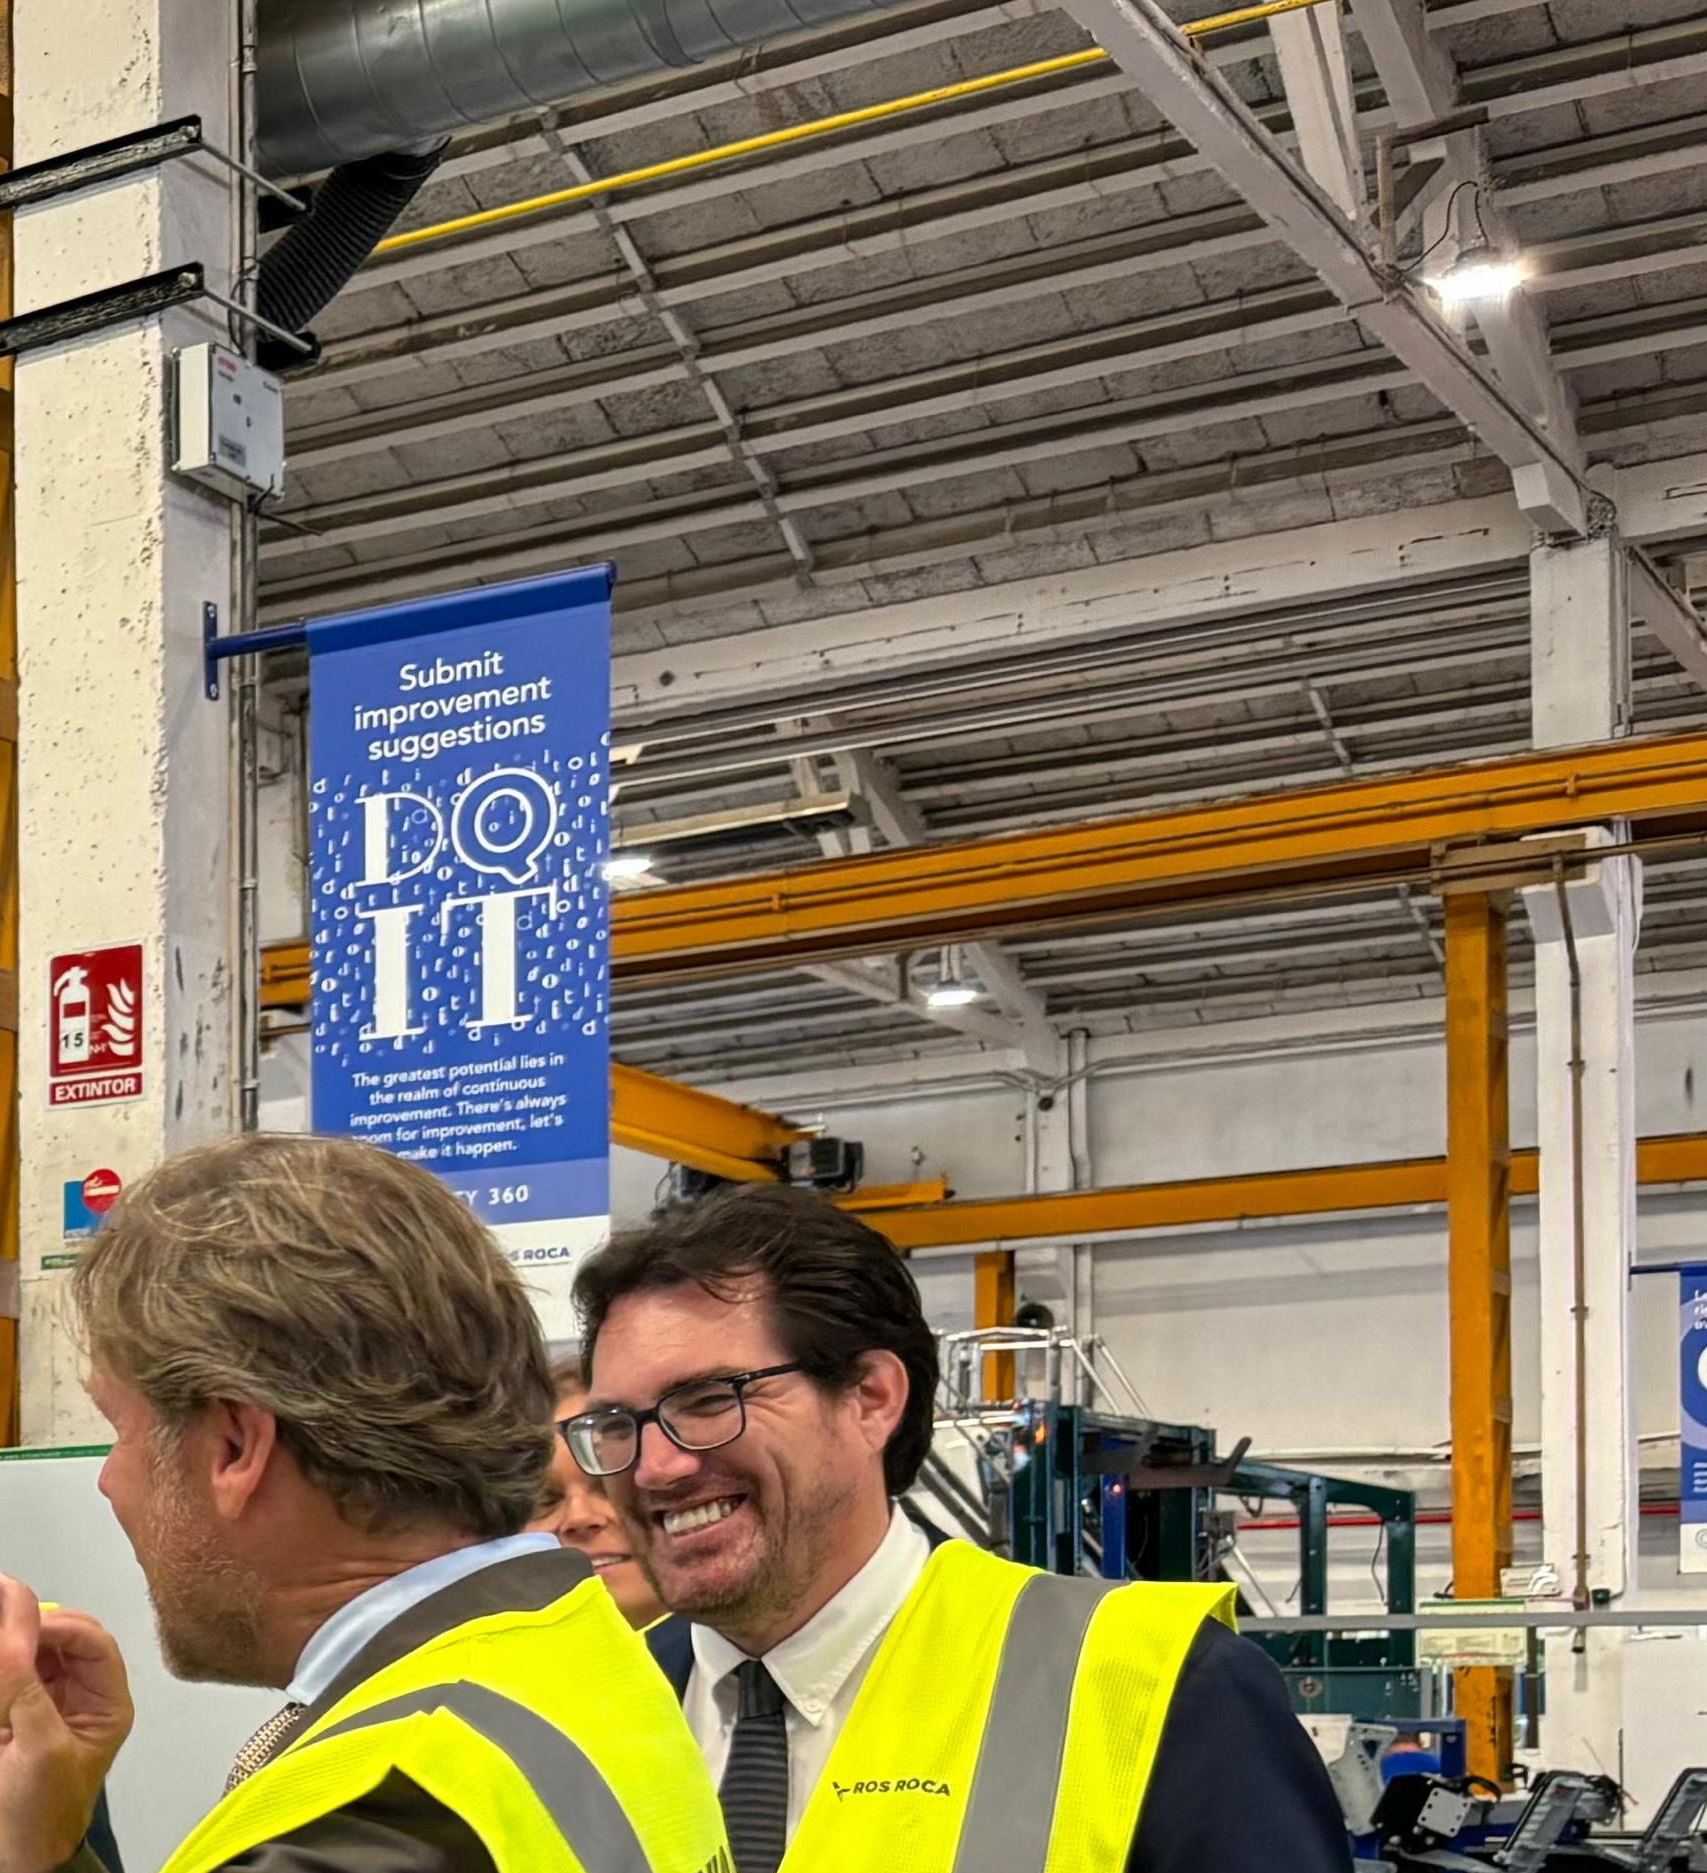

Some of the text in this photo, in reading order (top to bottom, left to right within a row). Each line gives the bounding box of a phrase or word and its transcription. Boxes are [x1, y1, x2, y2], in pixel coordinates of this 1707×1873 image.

[399, 651, 504, 691] Submit
[354, 676, 552, 733] improvement
[368, 714, 546, 762] suggestions
[358, 886, 557, 1041] IT
[62, 1033, 84, 1048] 15
[352, 1053, 565, 1088] The greatest potential lies in
[55, 1077, 136, 1101] EXTINTOR
[369, 1075, 547, 1106] the realm of continuous
[515, 1094, 567, 1114] always
[396, 1126, 419, 1142] for
[441, 1145, 453, 1158] it
[456, 1139, 517, 1159] happen.
[488, 1184, 530, 1206] 360
[523, 1247, 571, 1261] ROCA
[853, 1778, 951, 1797] ROS ROCA
